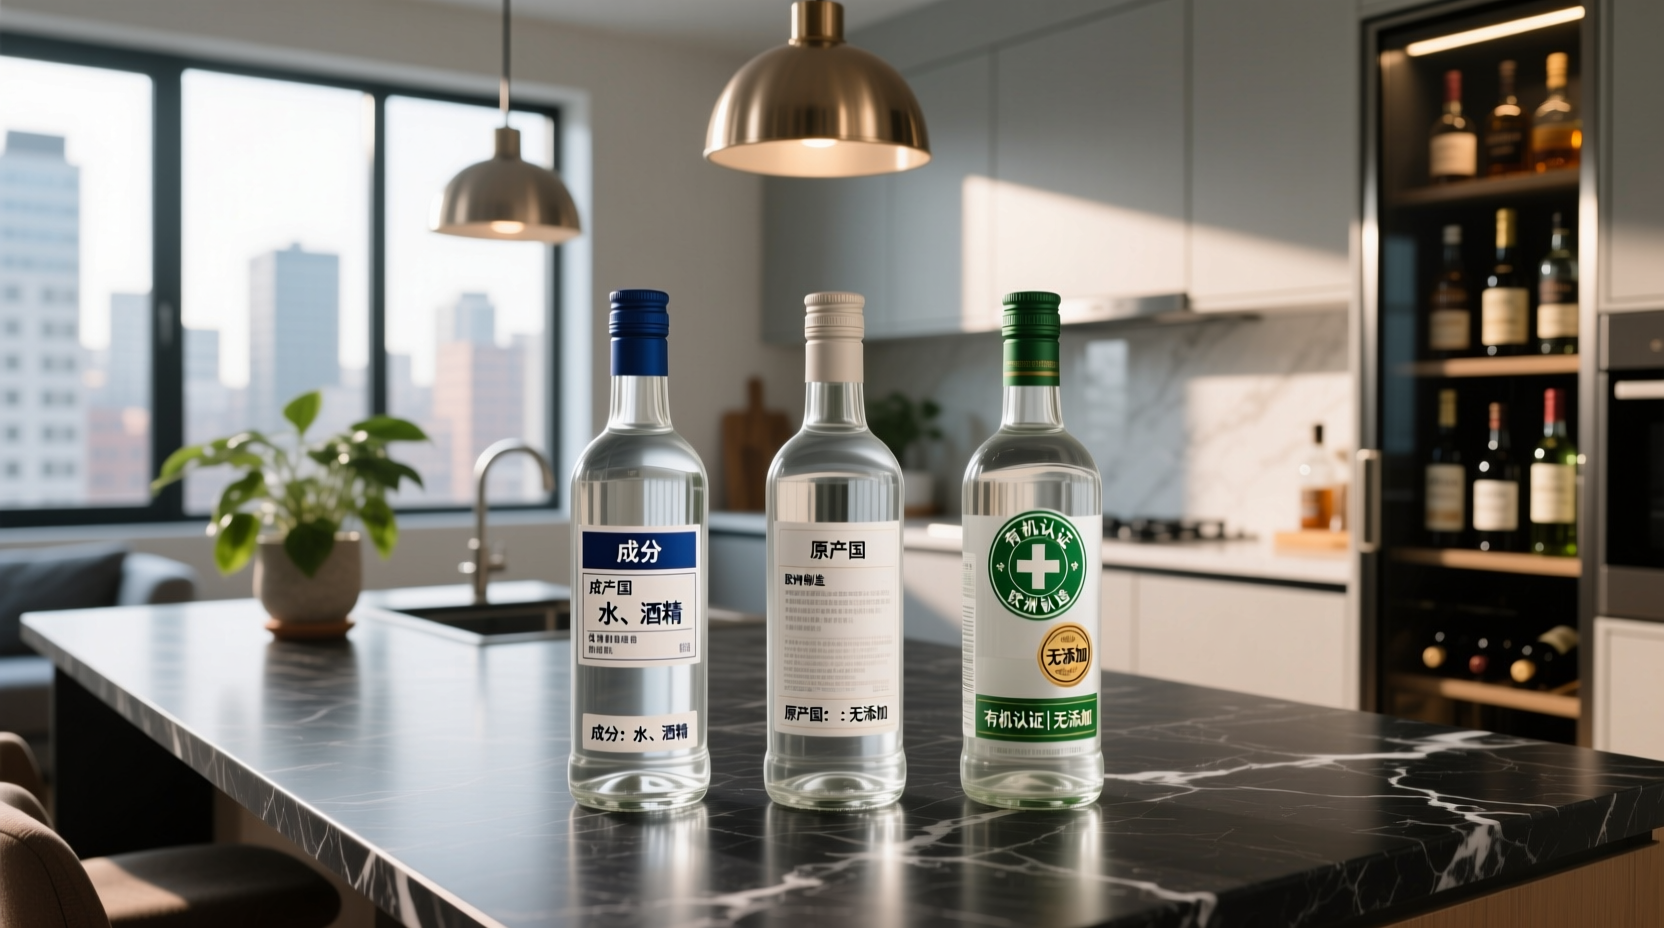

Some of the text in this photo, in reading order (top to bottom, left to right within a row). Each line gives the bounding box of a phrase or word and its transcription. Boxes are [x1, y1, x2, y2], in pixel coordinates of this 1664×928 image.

[1004, 518, 1074, 550] 有机认证
[616, 538, 662, 564] 成分
[809, 539, 867, 561] 原产国
[598, 599, 684, 627] 水、酒精
[1046, 644, 1088, 667] 无添加
